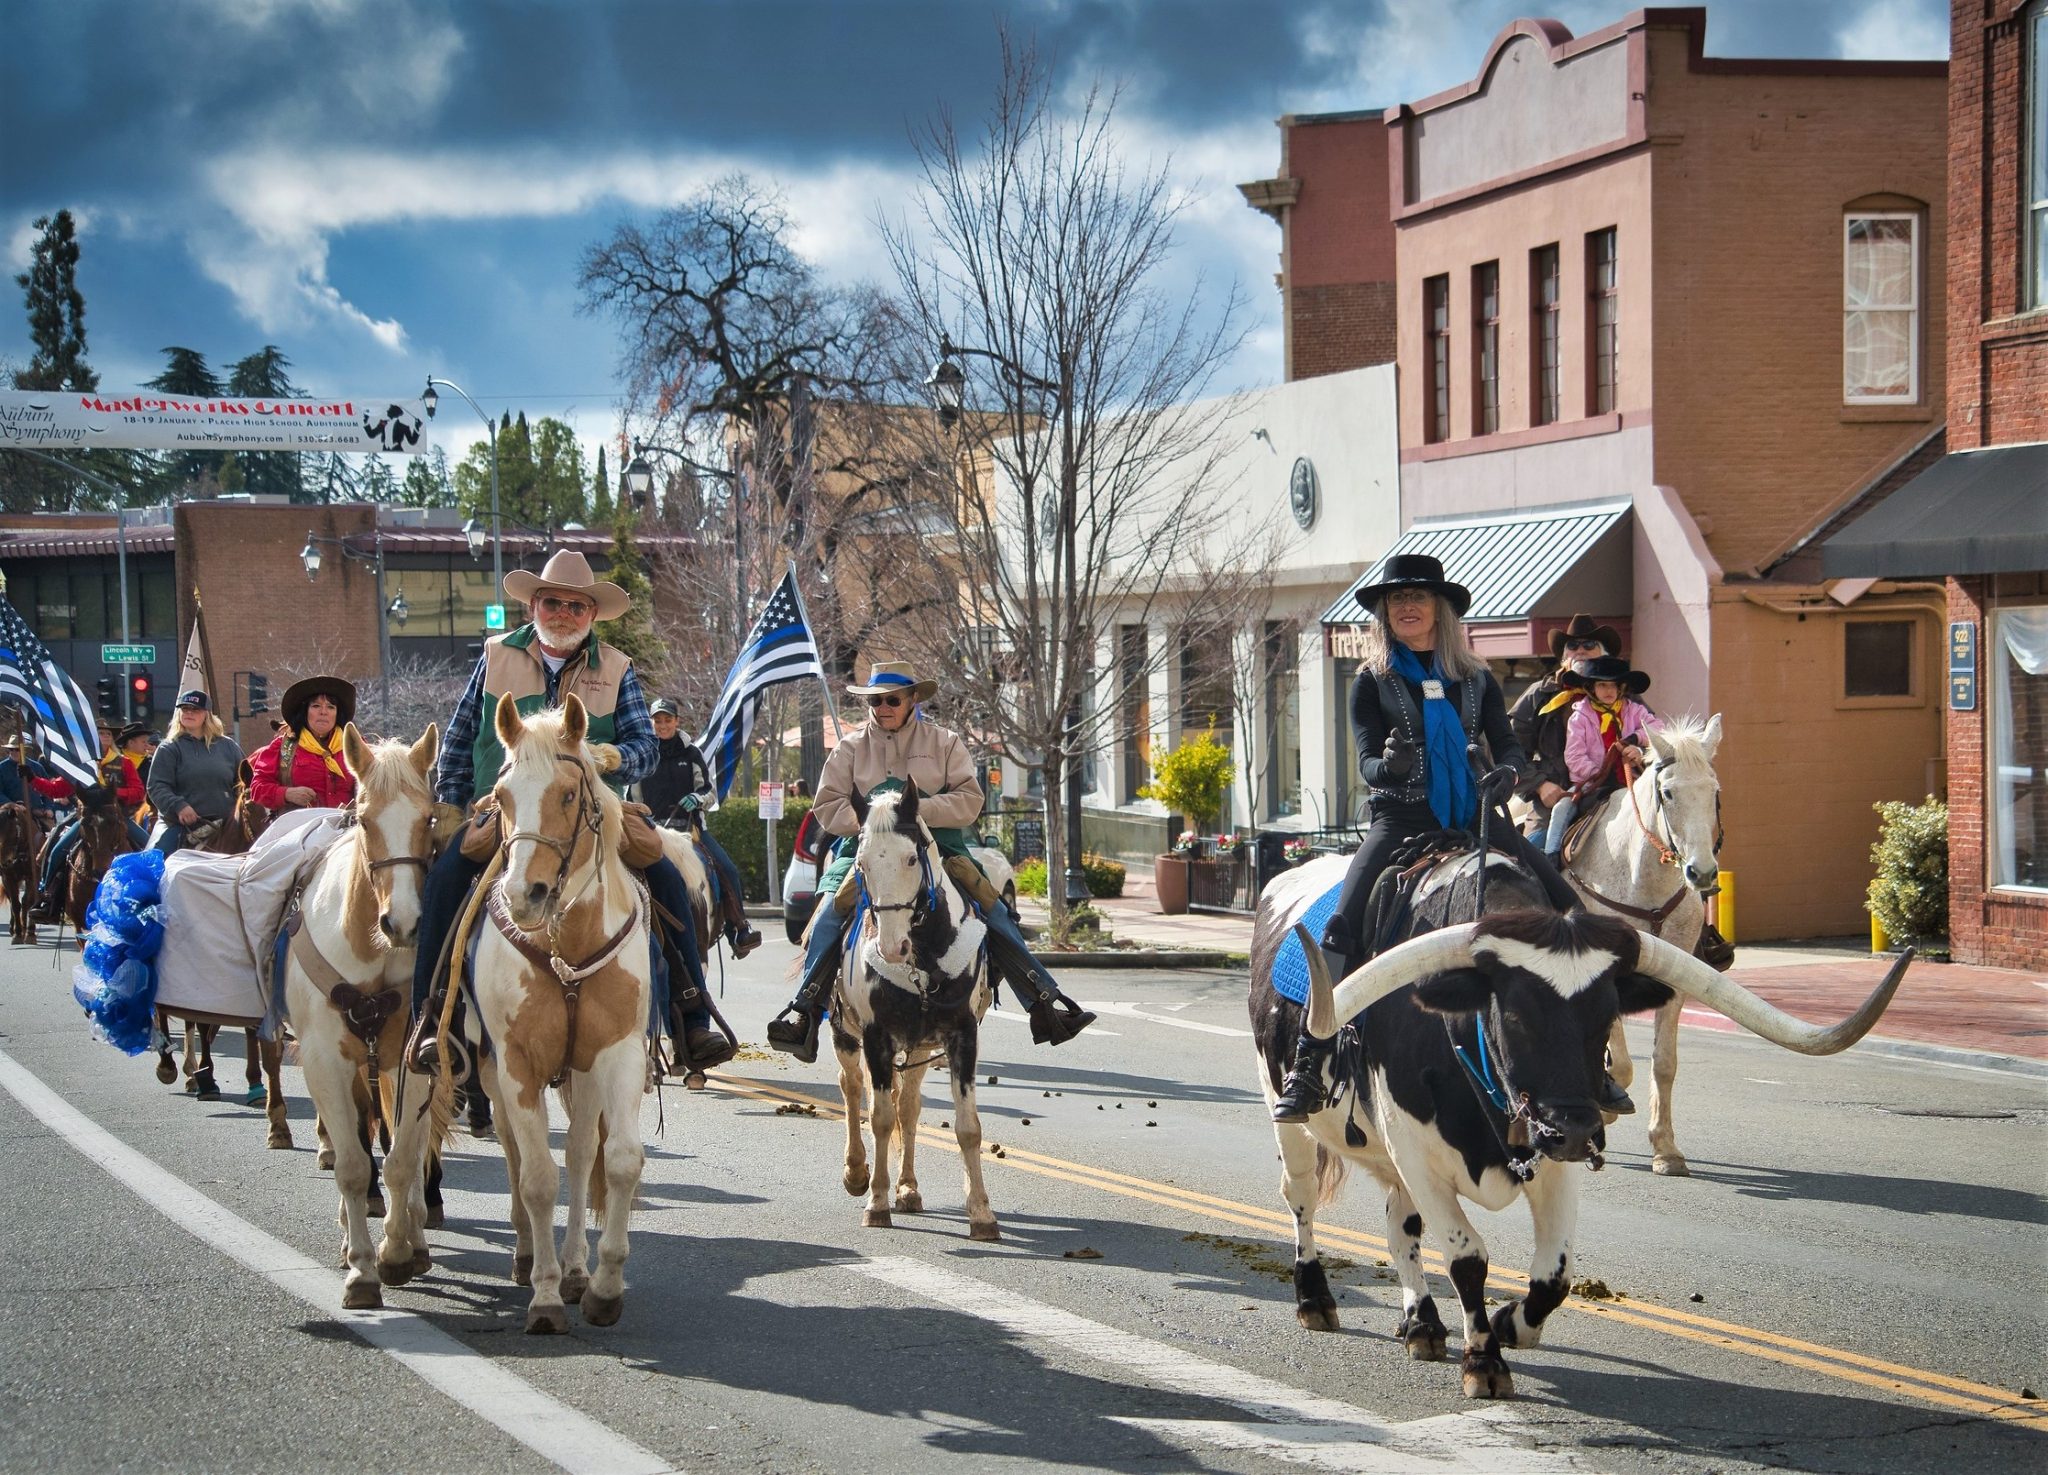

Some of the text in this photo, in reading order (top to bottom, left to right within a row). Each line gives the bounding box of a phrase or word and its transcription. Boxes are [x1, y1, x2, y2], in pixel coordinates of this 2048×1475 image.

[80, 396, 357, 416] Masterworks Concert
[124, 416, 154, 424] 18-19
[1955, 629, 1968, 643] 922
